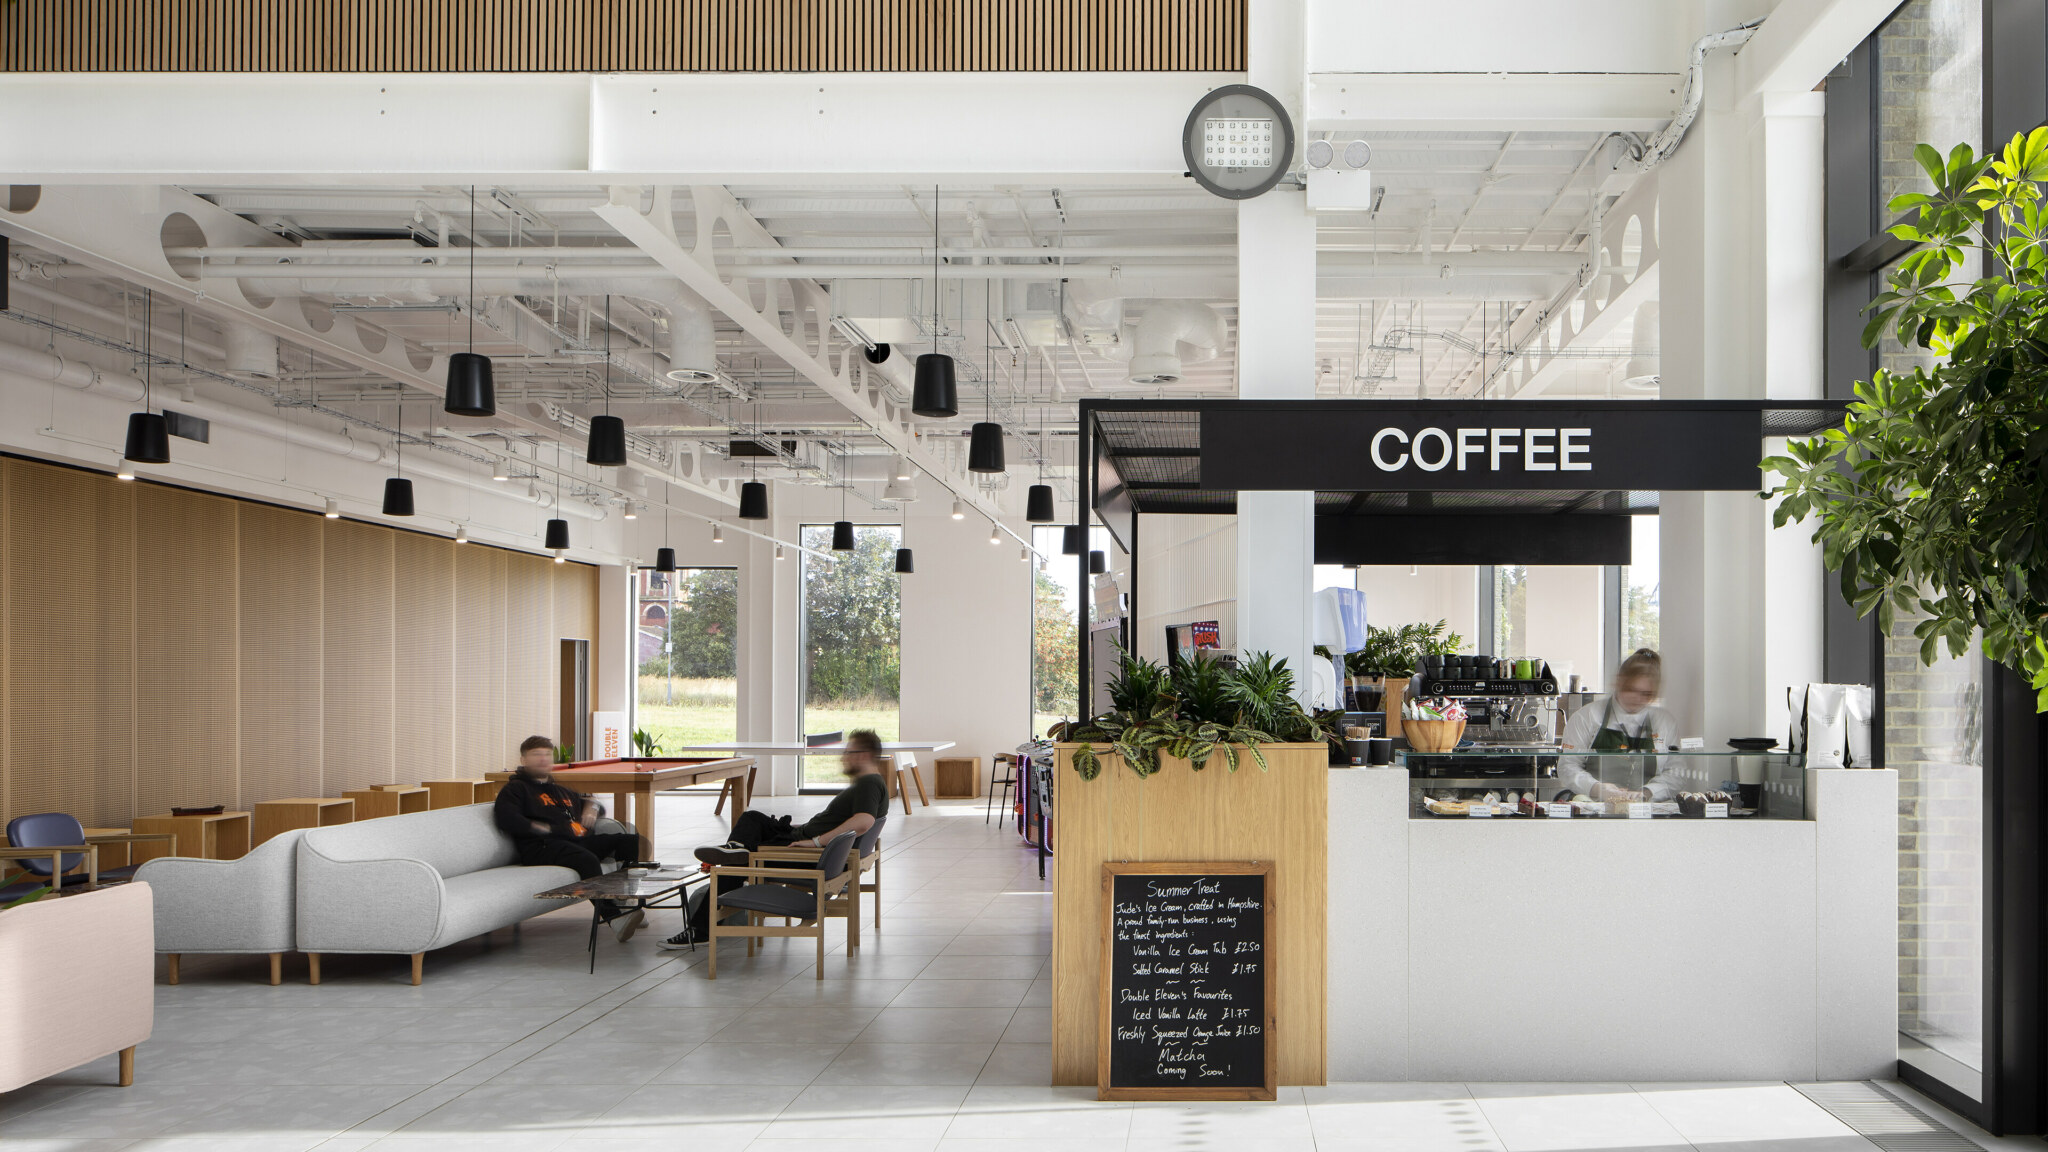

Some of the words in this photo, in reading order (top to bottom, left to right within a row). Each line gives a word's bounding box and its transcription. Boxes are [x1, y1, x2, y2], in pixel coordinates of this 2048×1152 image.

[1370, 427, 1592, 472] COFFEE
[1194, 631, 1217, 646] RUSH
[1147, 881, 1192, 898] Summer
[1193, 878, 1221, 895] Treat
[1115, 902, 1141, 914] Jude's
[1145, 901, 1157, 912] Ice
[1160, 901, 1187, 912] Cream,
[1188, 898, 1215, 911] crafted
[1218, 901, 1225, 909] in
[1117, 917, 1123, 926] A
[1124, 915, 1143, 929] proud
[1147, 914, 1180, 928] family-run
[1217, 915, 1237, 928] using
[1118, 929, 1130, 940] the
[1133, 928, 1151, 940] finest
[1133, 944, 1161, 956] Vanilla
[1168, 944, 1181, 956] Ice
[1188, 943, 1209, 956] Cream
[1234, 941, 1260, 954] £2.50
[1132, 963, 1151, 975] Salted
[1154, 962, 1185, 975] Caramel
[1189, 962, 1210, 974] Stick
[1231, 962, 1258, 975] £1.75
[1120, 988, 1150, 1004] Double
[1155, 988, 1187, 1001] Eleven's
[1193, 986, 1233, 1001] Favourites
[1132, 1007, 1151, 1020] Iced
[1158, 1006, 1181, 1019] Vanilla
[1187, 1007, 1208, 1020] Latte
[1221, 1007, 1251, 1020] £1.75
[1117, 1025, 1146, 1044] Freshly
[1151, 1024, 1189, 1045] Squeezed
[1192, 1026, 1214, 1042] Orange
[1215, 1024, 1231, 1037] Juice
[1235, 1024, 1261, 1037] £1.50
[1158, 1048, 1206, 1062] Matcha
[1156, 1063, 1187, 1079] Coming
[1199, 1064, 1231, 1077] Soon!
